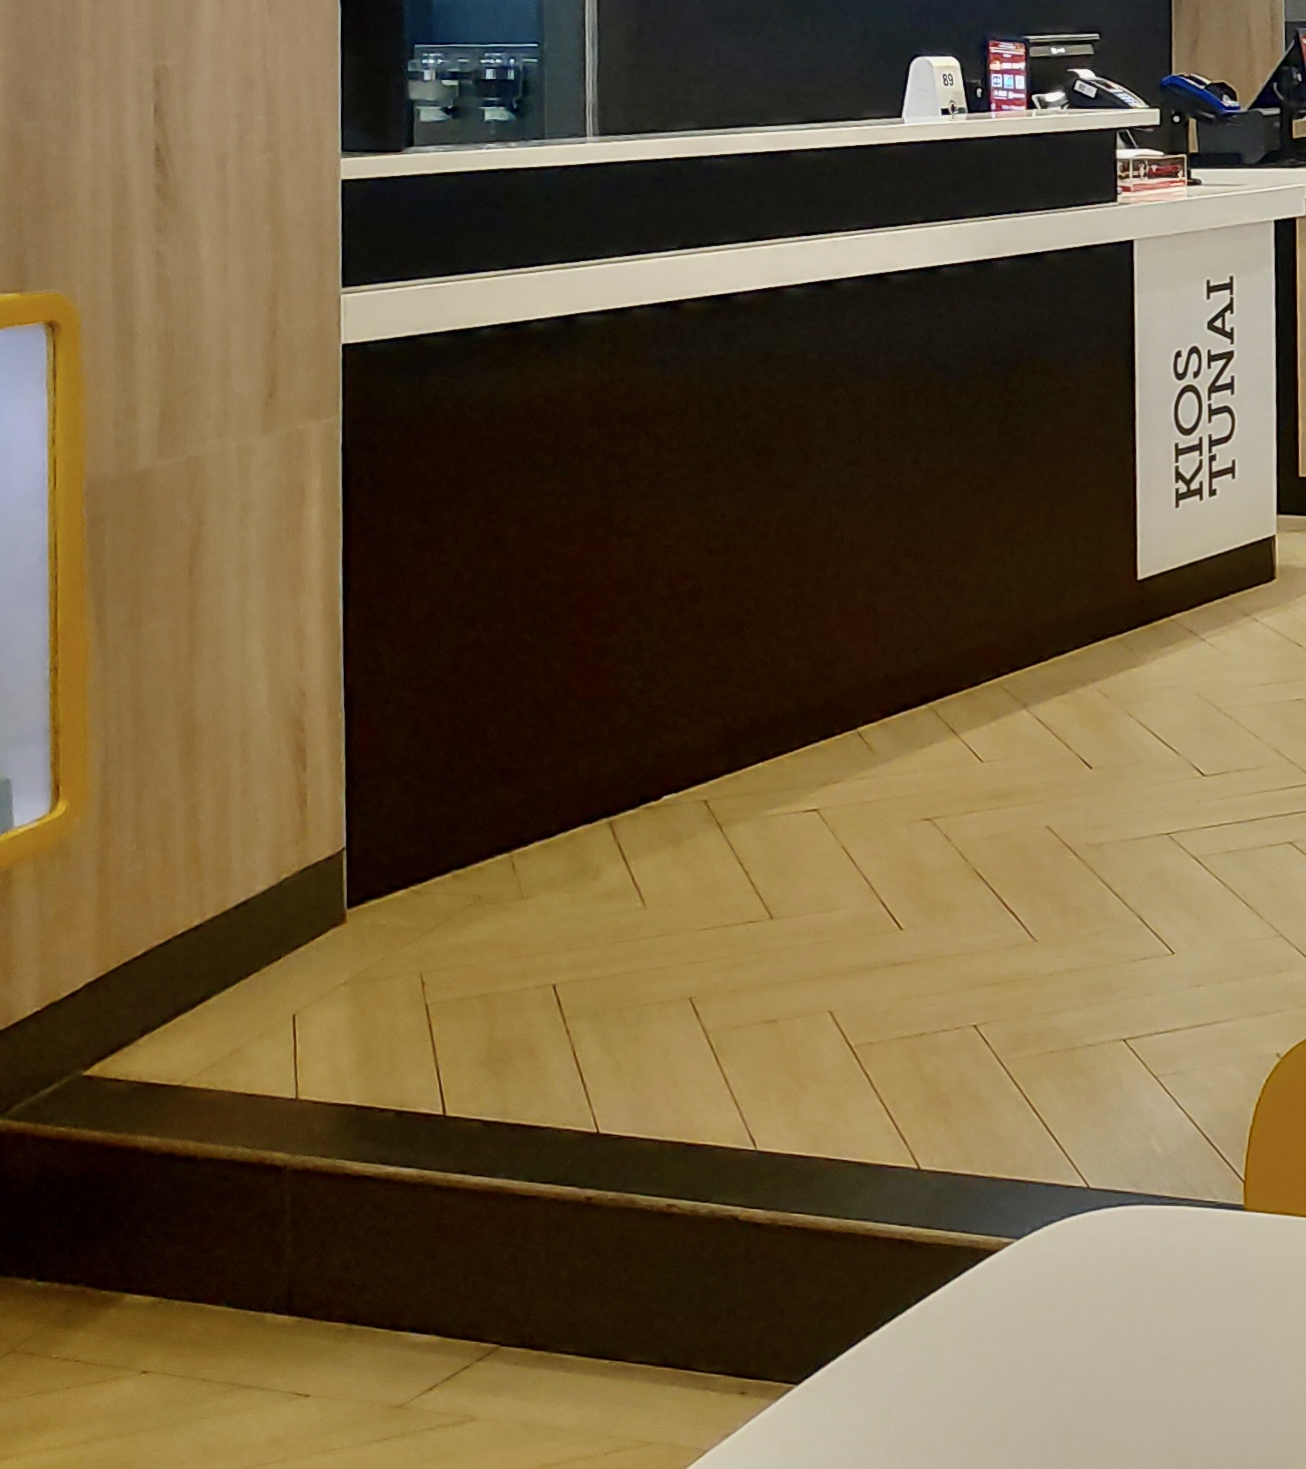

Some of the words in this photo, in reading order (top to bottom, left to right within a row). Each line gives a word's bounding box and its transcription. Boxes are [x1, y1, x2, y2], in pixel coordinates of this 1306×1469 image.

[942, 73, 954, 87] 89
[1173, 344, 1204, 509] KIOS
[1206, 275, 1237, 498] TUNAI
